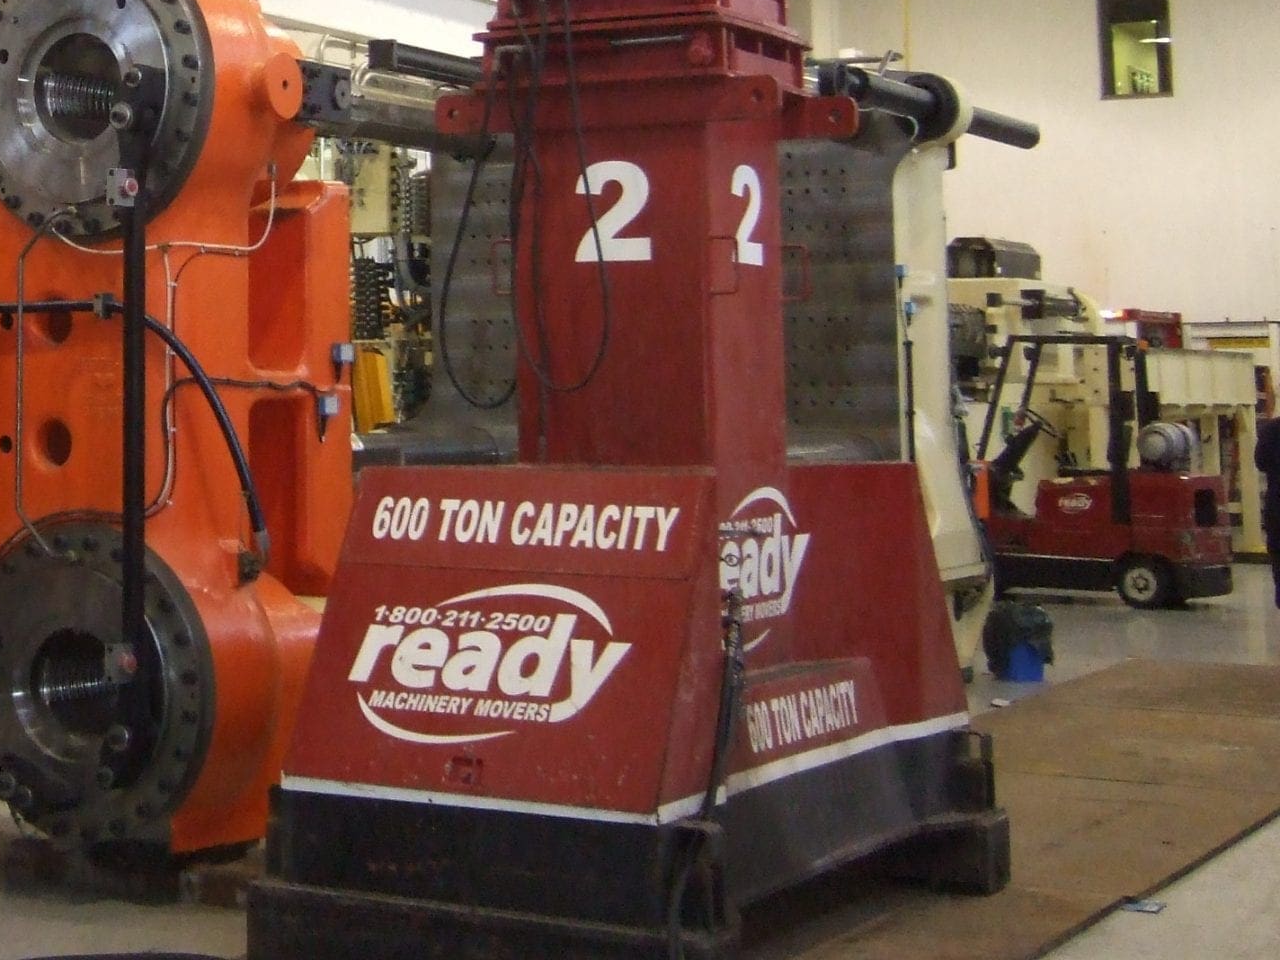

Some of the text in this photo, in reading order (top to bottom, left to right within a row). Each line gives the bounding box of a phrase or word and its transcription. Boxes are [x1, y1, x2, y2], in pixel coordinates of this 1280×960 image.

[575, 160, 651, 262] 2
[731, 164, 763, 266] 2
[372, 496, 680, 552] 600 TON CAPACITY
[719, 513, 811, 614] eady
[348, 613, 633, 722] ready
[369, 690, 552, 723] MACHINERY MOVERS
[746, 680, 858, 753] 600 TON CAPACITY
